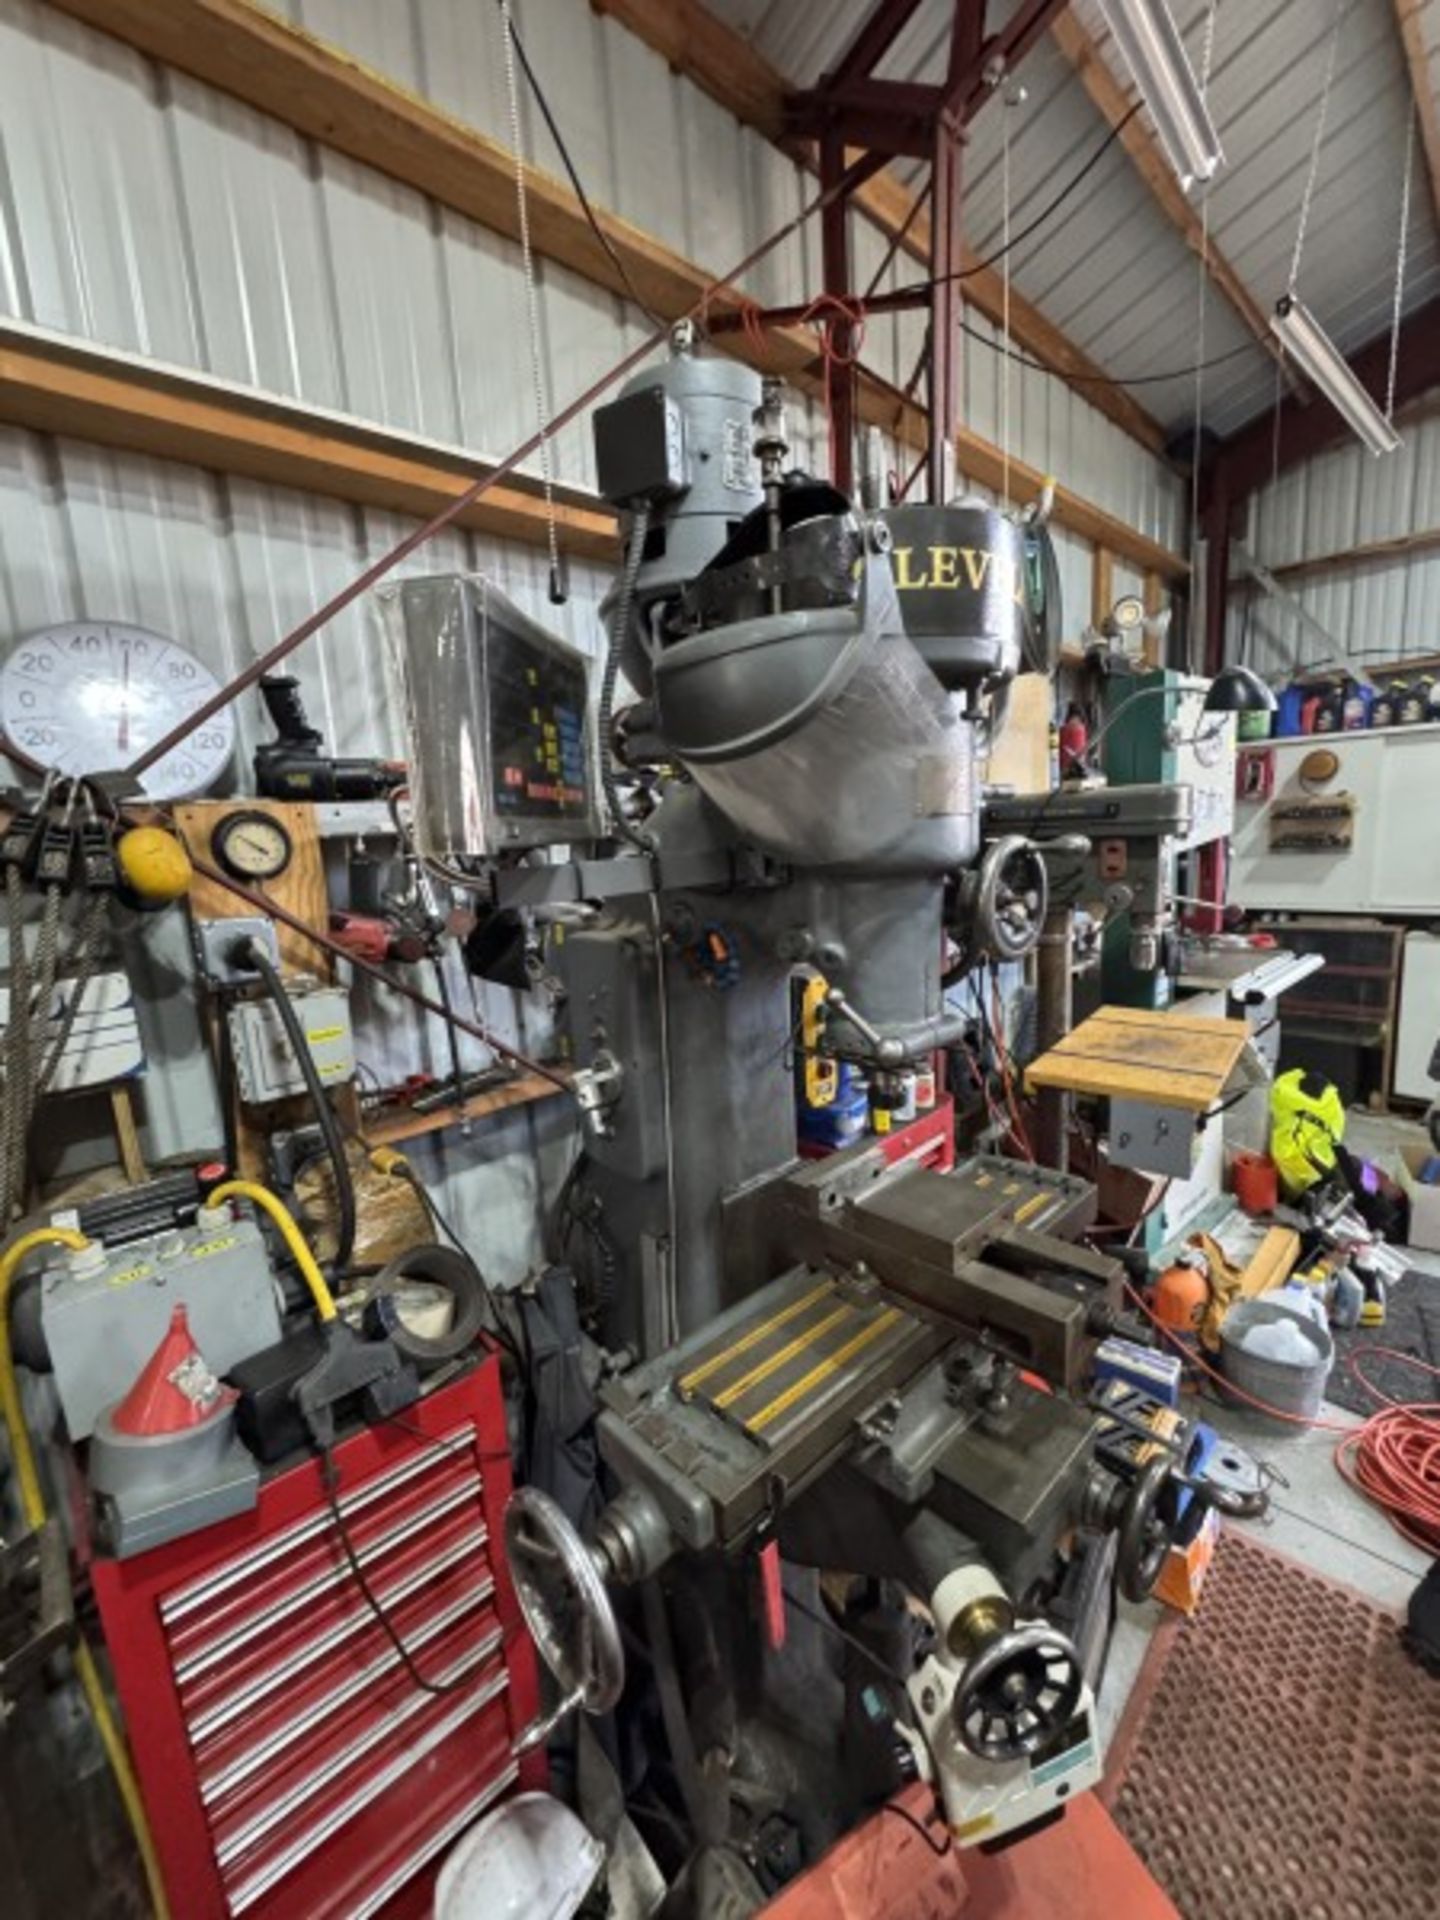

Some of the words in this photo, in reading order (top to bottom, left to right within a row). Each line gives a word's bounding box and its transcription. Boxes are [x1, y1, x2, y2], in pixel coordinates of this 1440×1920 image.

[69, 635, 101, 652] 40
[19, 652, 55, 673] 20
[168, 661, 197, 679] 80
[18, 690, 36, 708] 0
